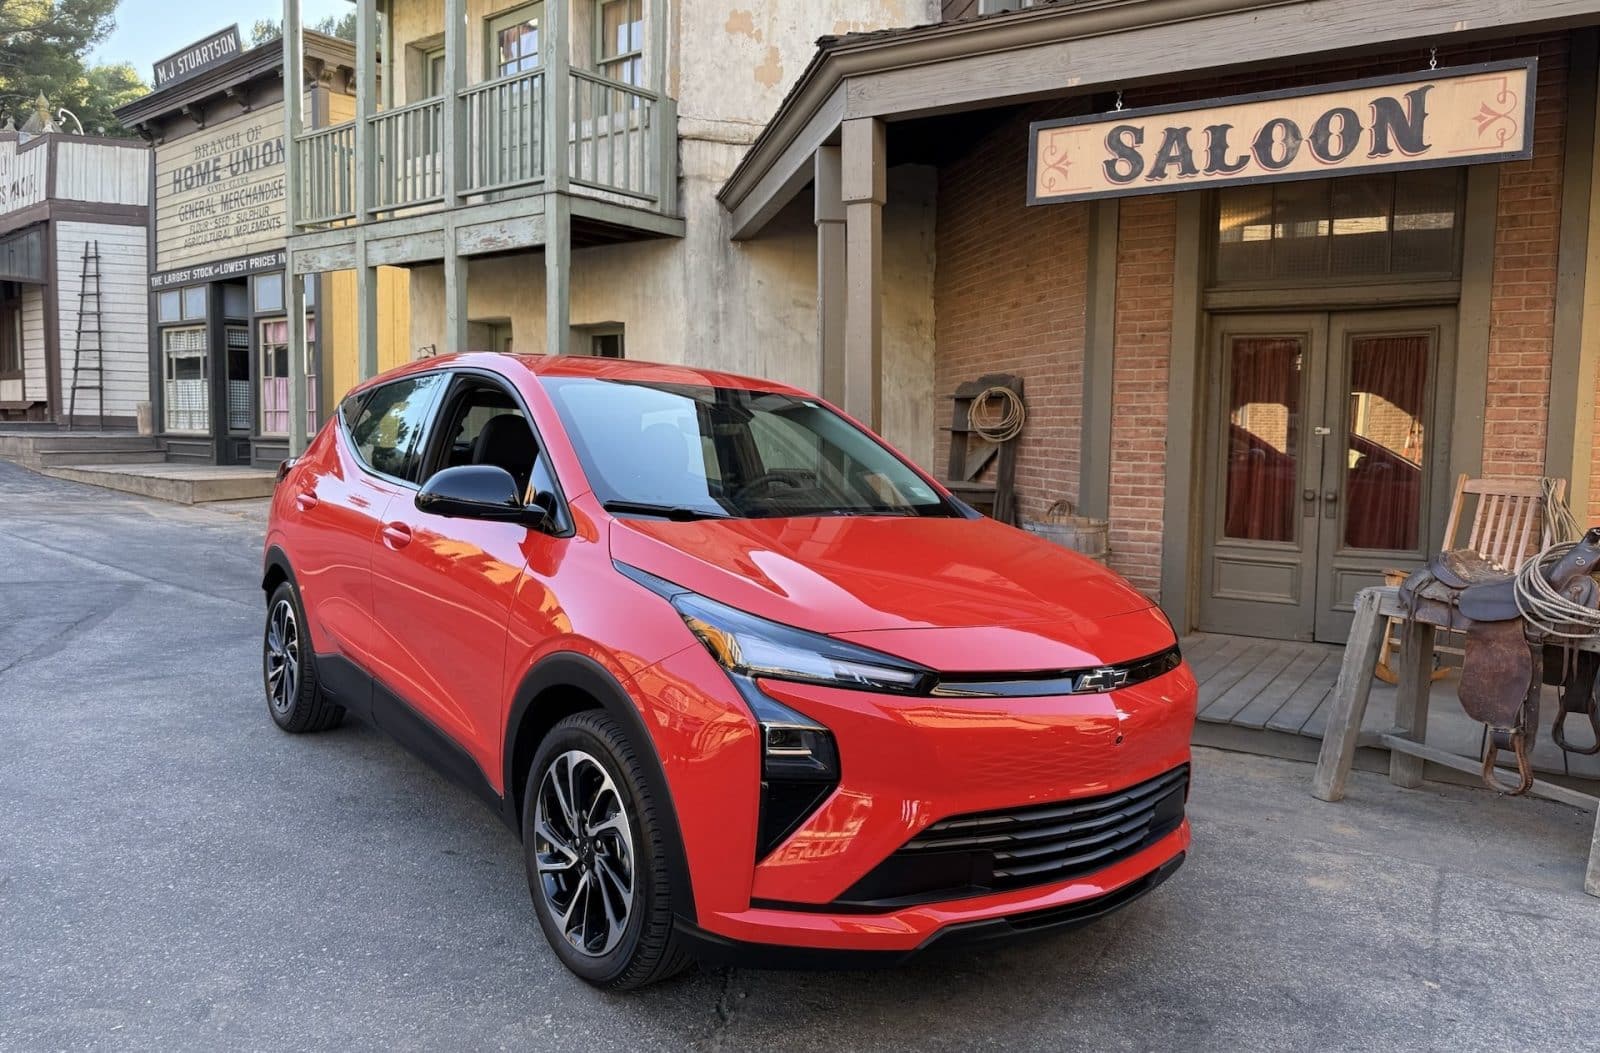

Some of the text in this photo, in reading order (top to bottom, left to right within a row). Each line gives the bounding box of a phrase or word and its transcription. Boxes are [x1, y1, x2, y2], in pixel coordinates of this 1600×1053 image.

[178, 33, 236, 74] STUARTSON
[194, 125, 262, 160] BRANCH OF
[1102, 85, 1435, 184] SALOON
[173, 138, 285, 194] HOME UNION
[179, 179, 284, 222] GENERAL MERCHANDISE
[215, 215, 229, 229] SEED
[236, 206, 270, 224] SULPHUR
[234, 216, 281, 238] IMPLEMENTS
[151, 276, 162, 287] THE
[164, 270, 191, 284] LARGEST
[193, 265, 213, 280] STOCK
[220, 258, 247, 274] LOWEST
[250, 254, 276, 269] PRICES
